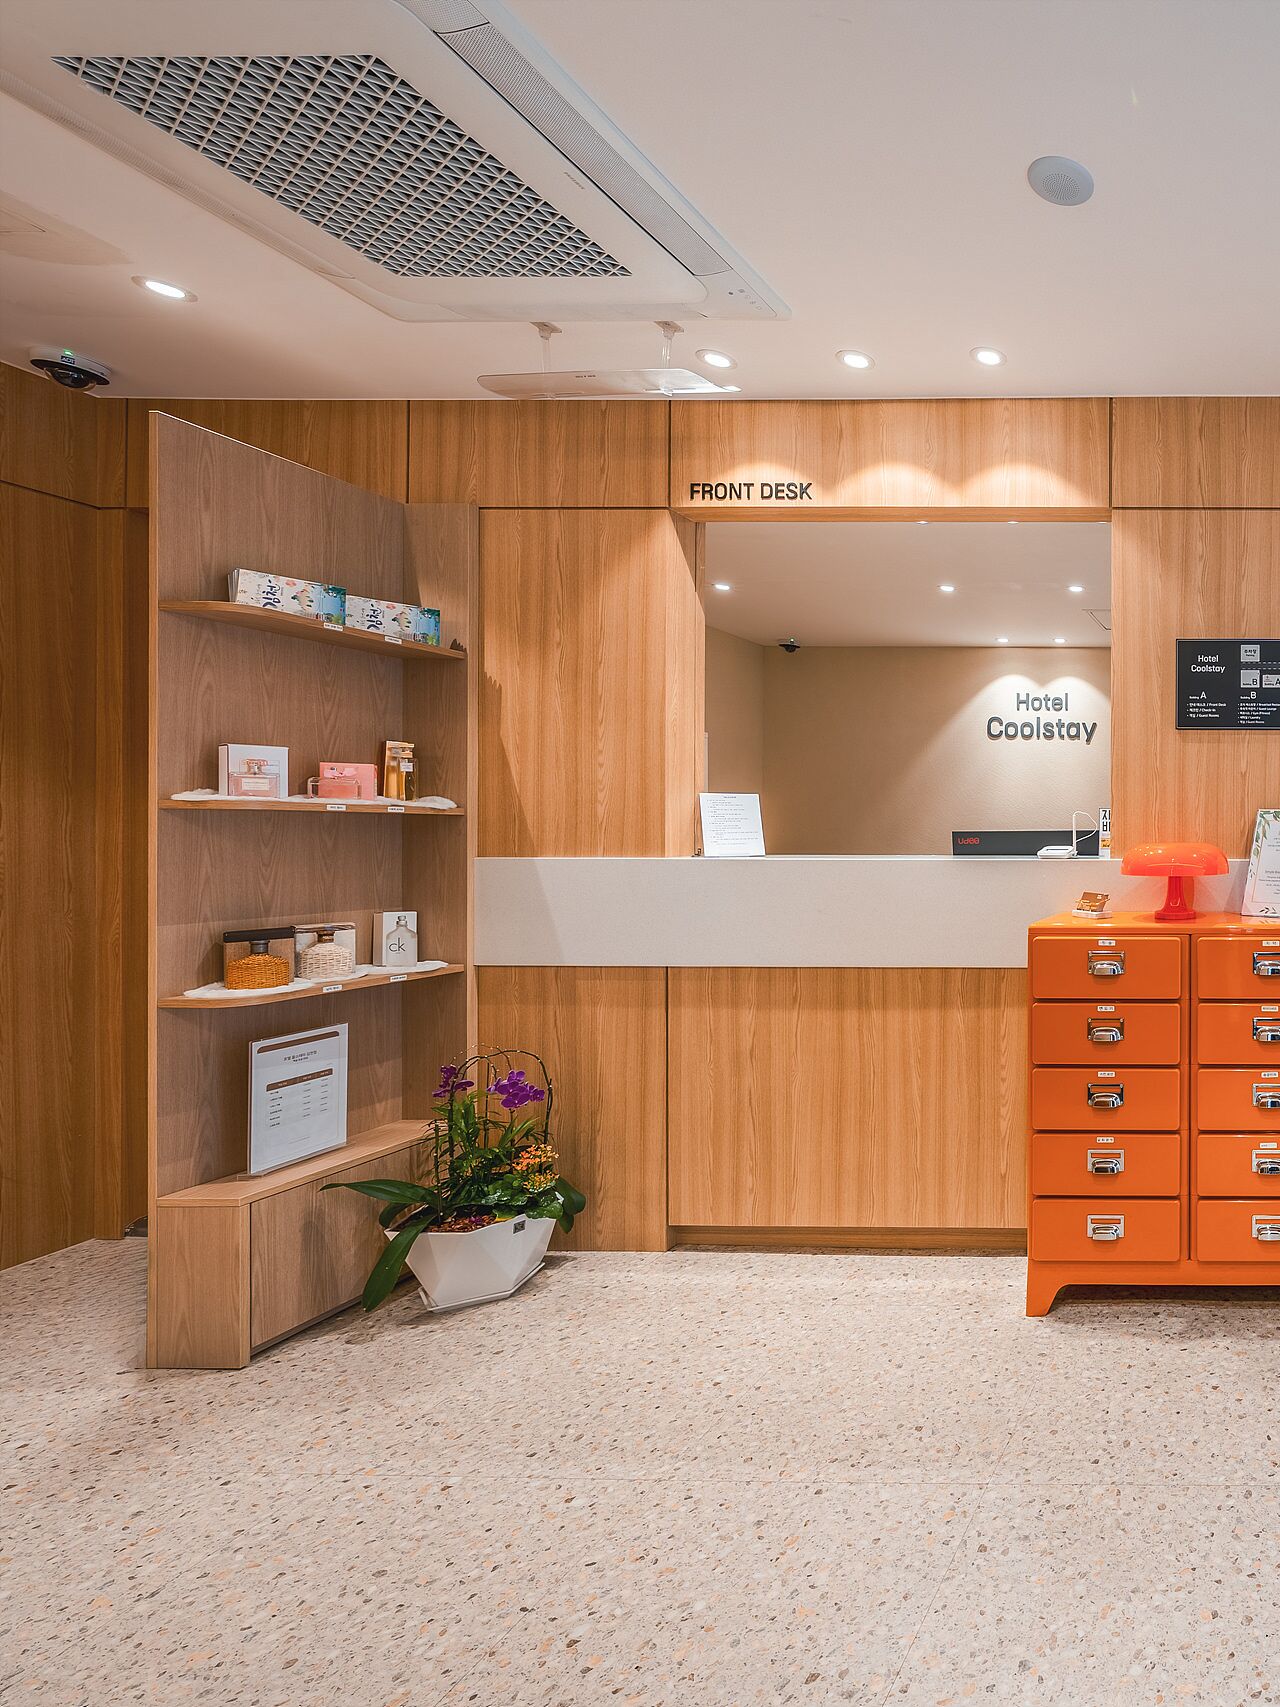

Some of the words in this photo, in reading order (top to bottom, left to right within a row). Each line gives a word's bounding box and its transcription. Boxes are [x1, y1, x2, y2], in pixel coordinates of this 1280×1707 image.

[689, 482, 755, 501] FRONT
[760, 482, 813, 501] DESK
[1191, 664, 1225, 673] Coolstay
[1016, 692, 1069, 712] Hotel
[1200, 691, 1207, 699] A
[1250, 691, 1257, 699] B
[987, 716, 1098, 745] Coolstay
[388, 937, 406, 952] ck
